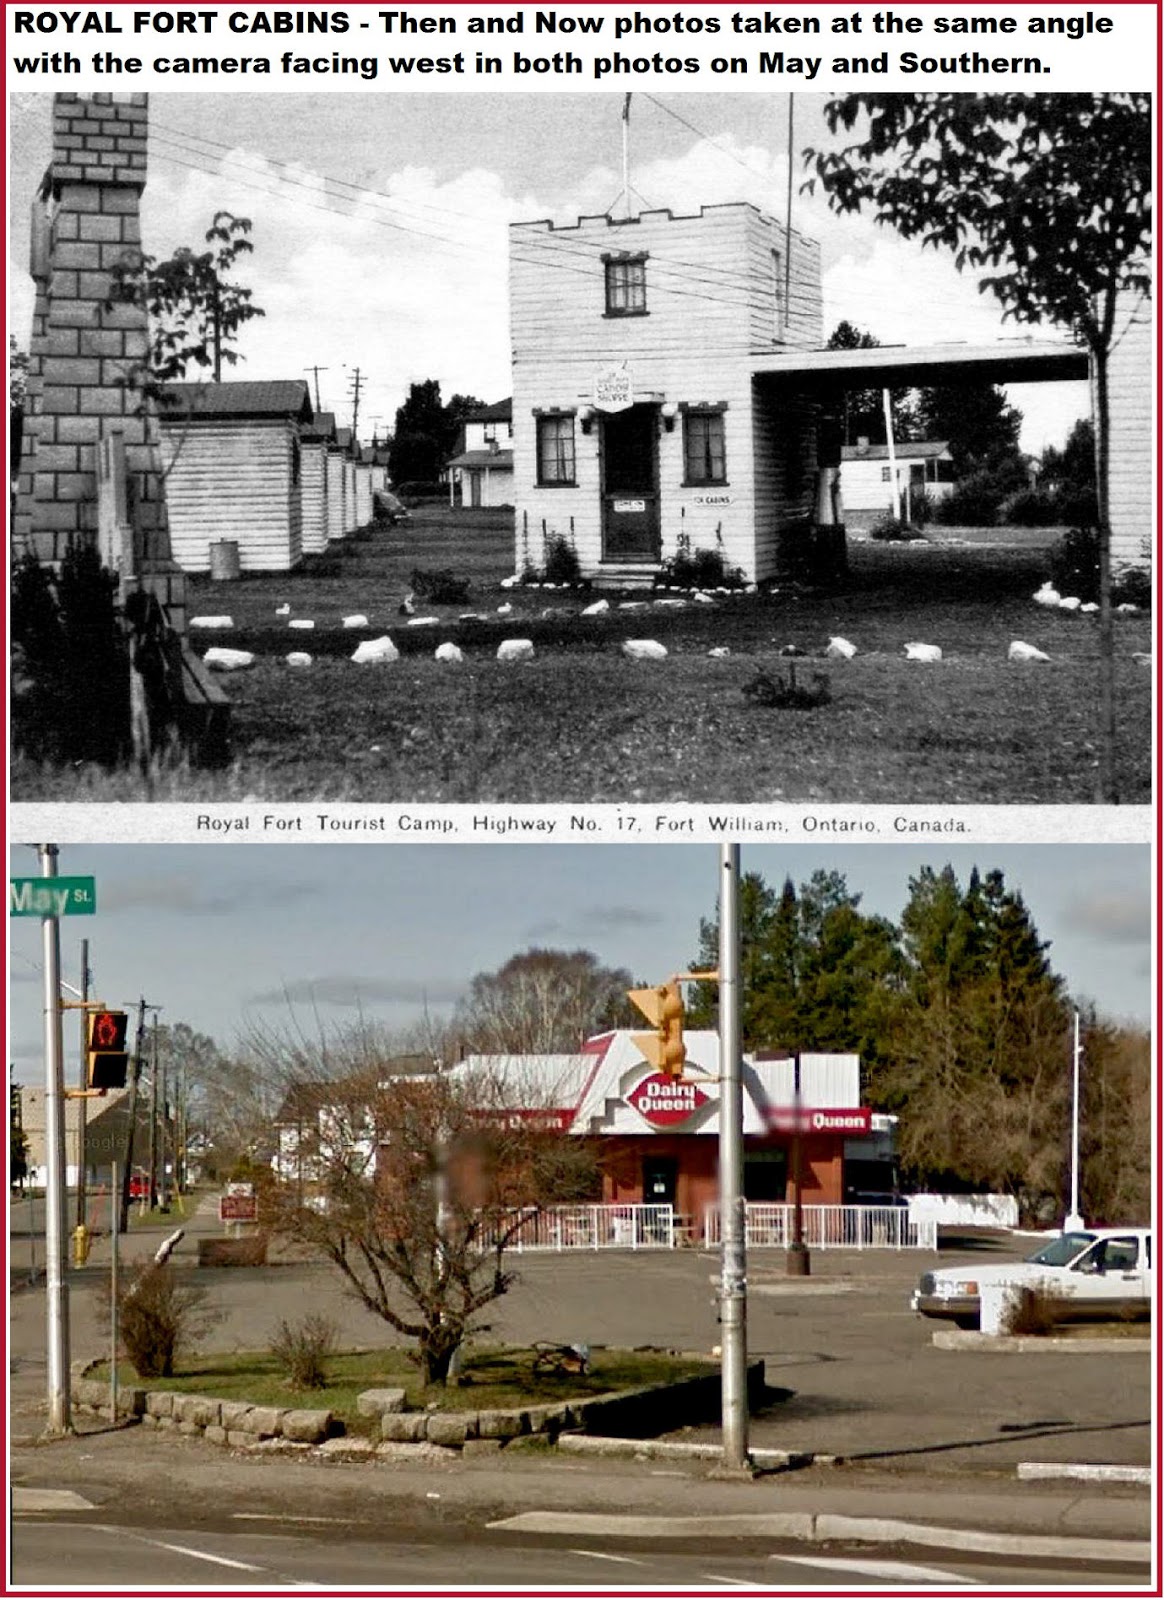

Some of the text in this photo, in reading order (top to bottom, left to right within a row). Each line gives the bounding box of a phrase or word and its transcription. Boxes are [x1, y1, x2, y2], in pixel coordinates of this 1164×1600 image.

[705, 496, 730, 504] CABINS
[10, 882, 69, 915] May
[646, 1081, 695, 1098] Dairy
[638, 1096, 696, 1113] Queen
[813, 1112, 866, 1129] Queen
